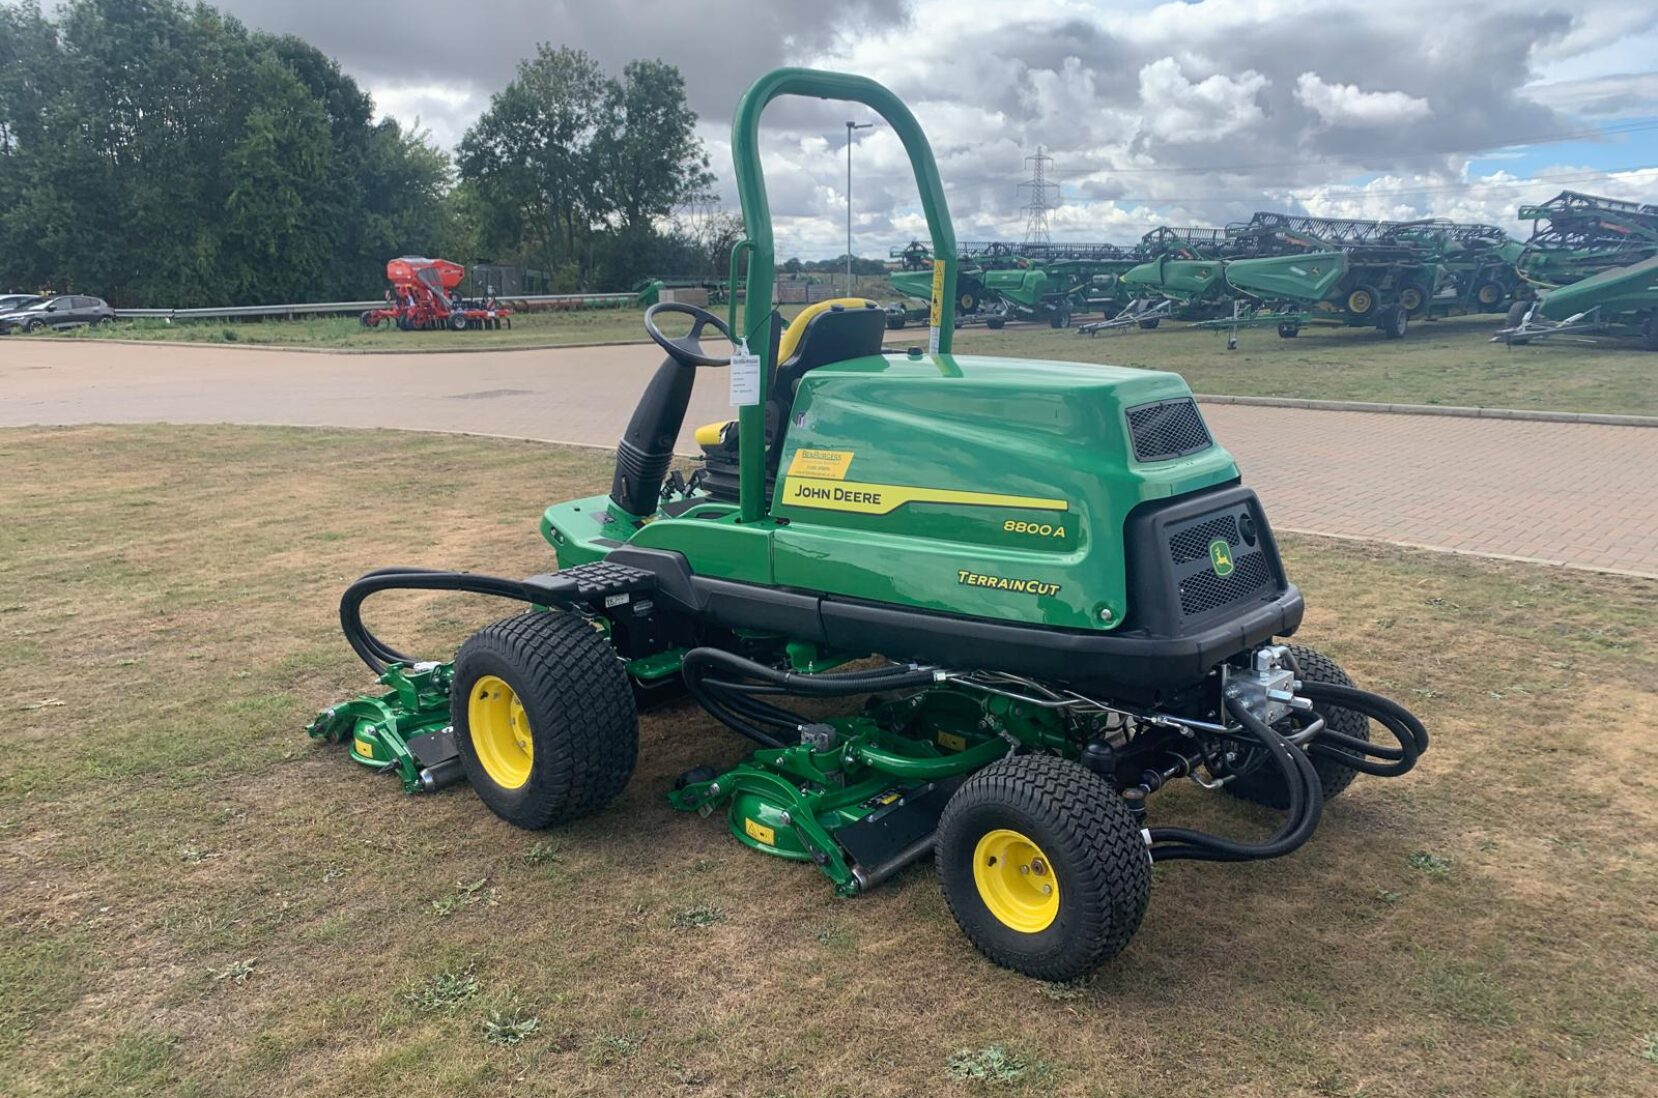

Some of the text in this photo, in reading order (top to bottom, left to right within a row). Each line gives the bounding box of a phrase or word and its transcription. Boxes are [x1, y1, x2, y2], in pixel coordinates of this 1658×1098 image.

[794, 484, 882, 505] JOHN DEERE
[958, 569, 1061, 597] TERRAINCUT
